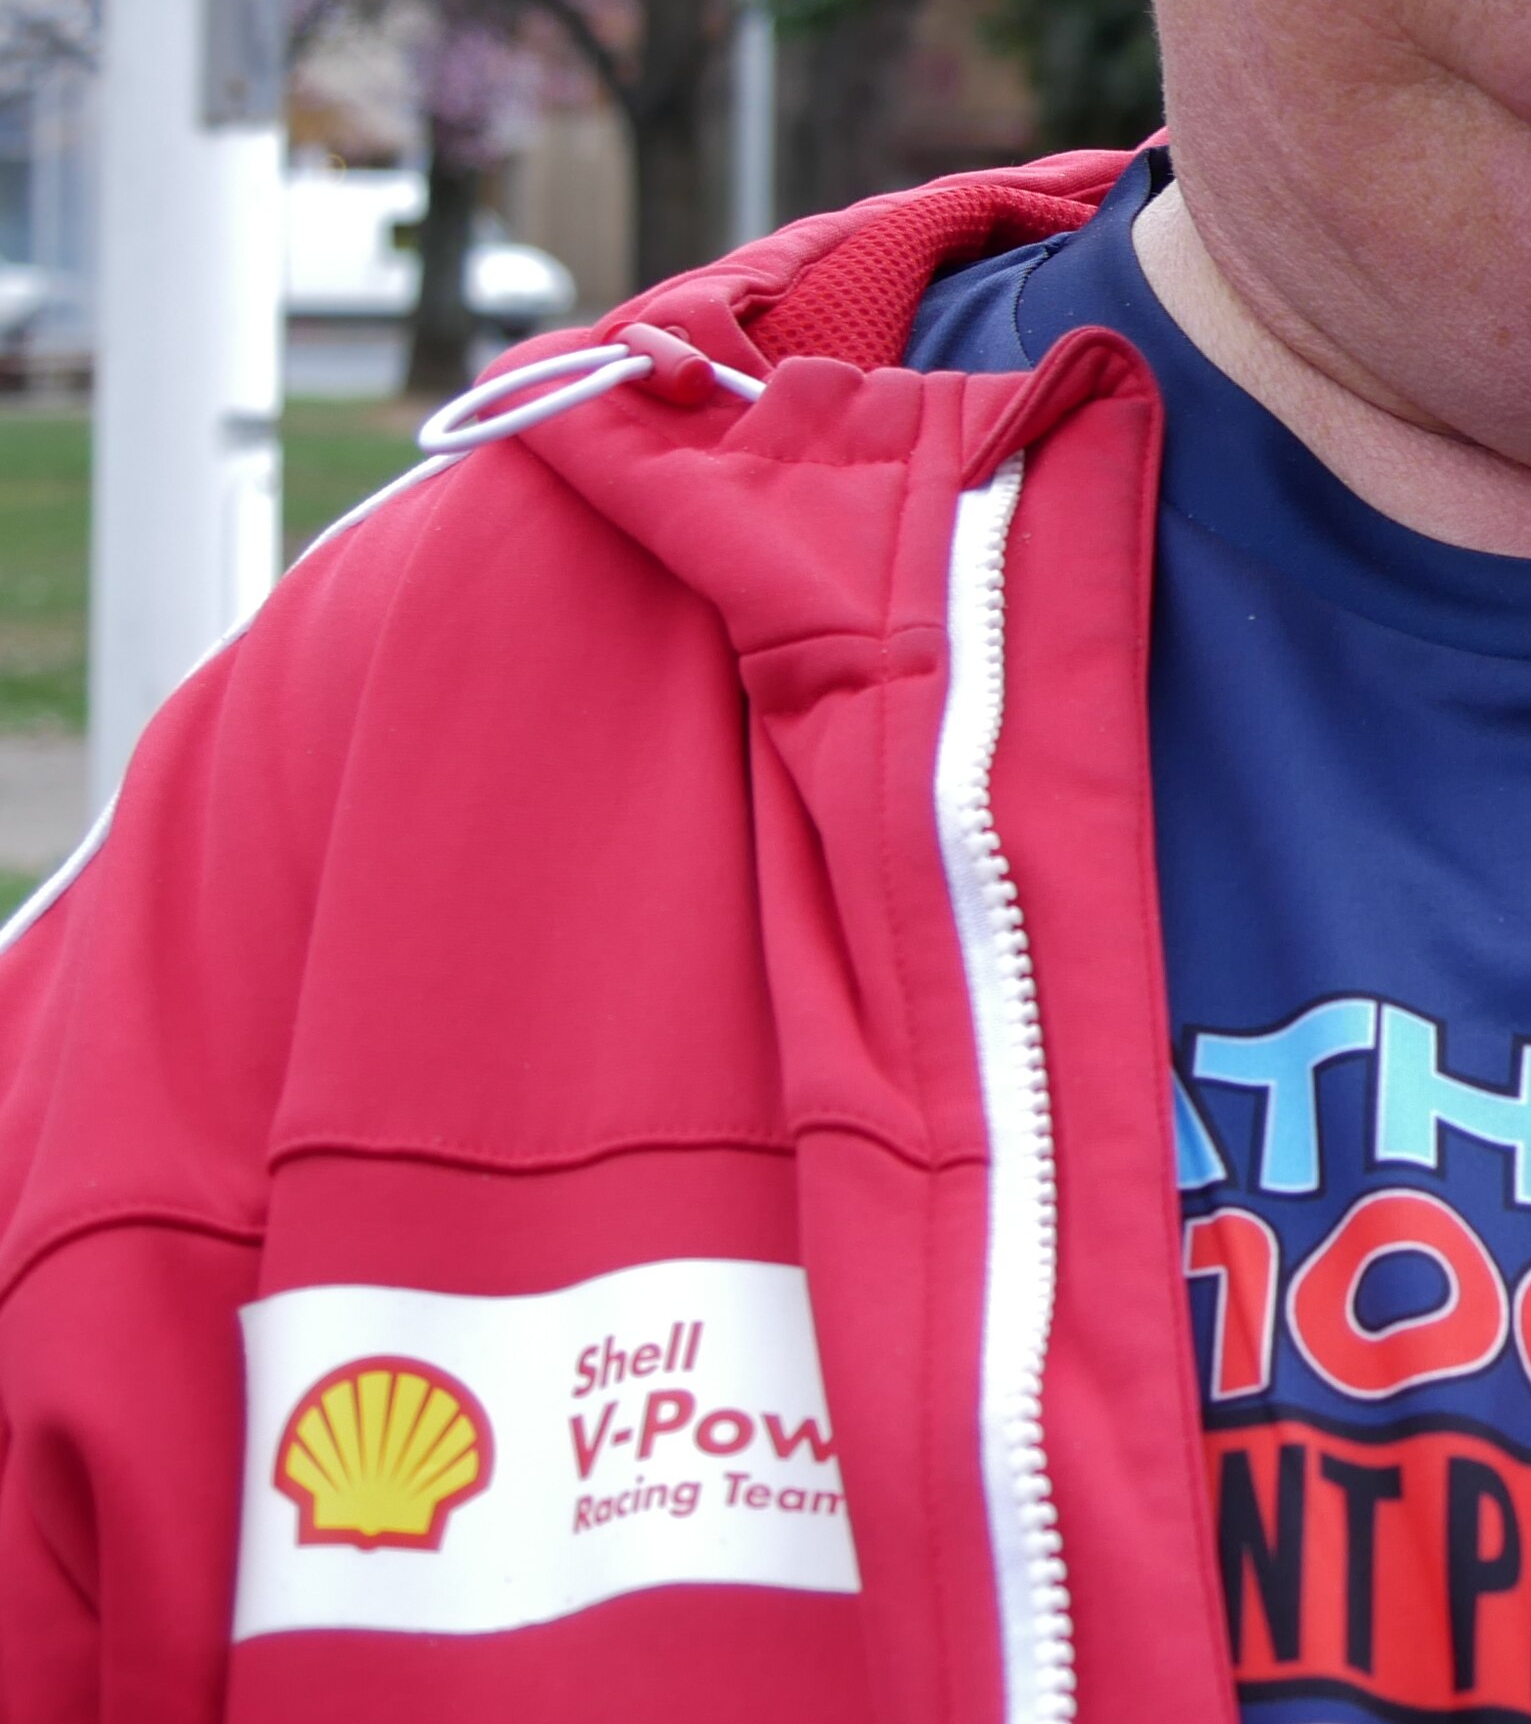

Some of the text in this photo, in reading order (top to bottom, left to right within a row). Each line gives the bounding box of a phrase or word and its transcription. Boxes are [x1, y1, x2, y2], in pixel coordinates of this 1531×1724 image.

[571, 1320, 704, 1399] Shell
[572, 1475, 702, 1535] Racing
[1217, 1442, 1403, 1677] NT
